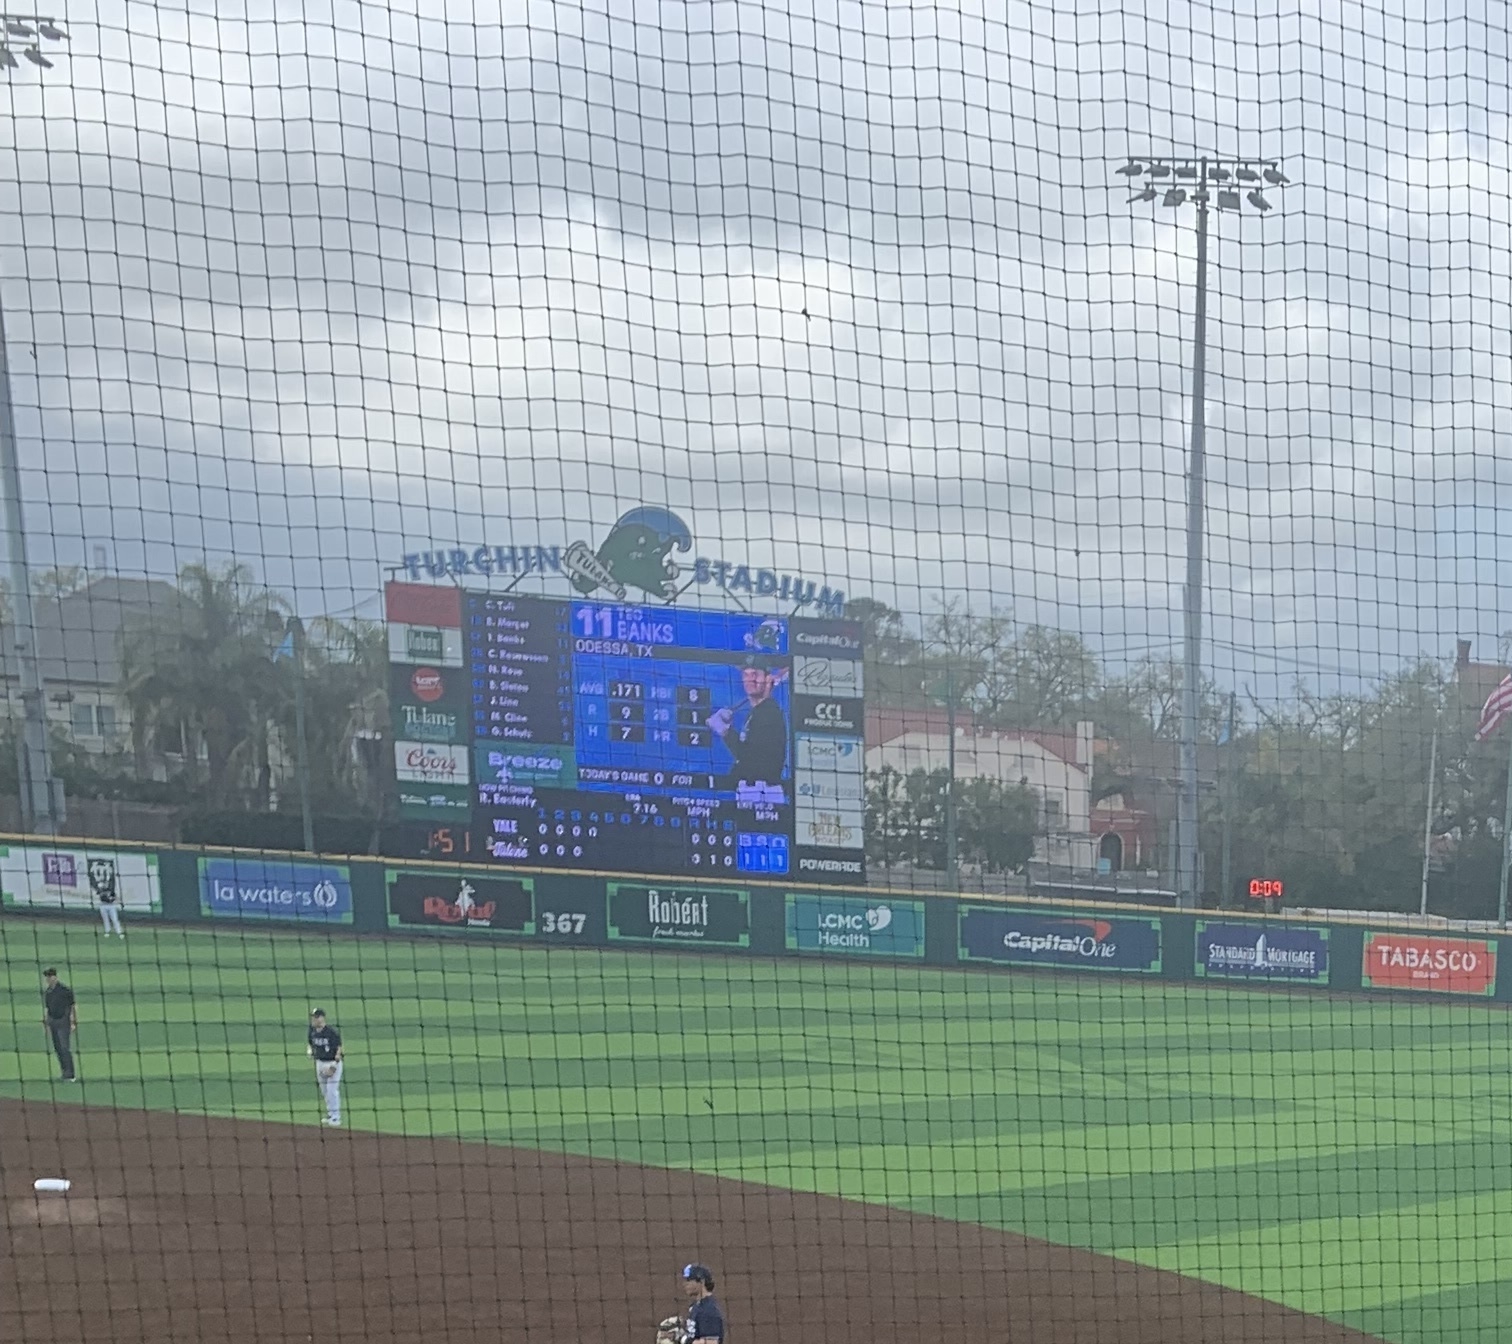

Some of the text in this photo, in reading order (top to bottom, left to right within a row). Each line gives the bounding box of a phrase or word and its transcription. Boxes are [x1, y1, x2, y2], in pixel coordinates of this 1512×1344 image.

[404, 545, 846, 618] TURCHIN STADIUM
[577, 606, 612, 637] 11
[617, 607, 643, 621] TEO
[617, 621, 674, 643] BANKS
[576, 639, 654, 657] ODESSA, TX
[580, 683, 604, 695] AVG
[611, 683, 640, 697] .171
[689, 689, 698, 702] 8
[588, 704, 597, 715] R
[622, 706, 631, 719] 9
[691, 711, 697, 724] 1
[588, 726, 699, 745] H 7 HR 2
[407, 748, 457, 770] Coors
[488, 751, 563, 770] Breeze
[621, 771, 649, 782] GAME
[654, 772, 664, 785] 0
[672, 775, 692, 785] FOR
[708, 776, 714, 788] 1
[493, 819, 518, 834] YALE
[539, 823, 547, 835] 0
[556, 824, 564, 836] 0
[572, 825, 581, 837] 0
[692, 833, 700, 845] 0
[708, 834, 716, 846] 0
[723, 835, 732, 847] 0
[540, 843, 548, 855] 0
[556, 844, 565, 857] 0
[573, 845, 582, 857] 0
[710, 854, 716, 865] 1
[724, 855, 732, 867] 0
[799, 858, 862, 873] POWERADE
[238, 885, 312, 906] waters
[542, 911, 587, 934] 367
[817, 913, 863, 931] LCMC
[818, 931, 870, 948] Health
[1208, 943, 1316, 965] STANDARD MORTGAGE
[1377, 945, 1477, 972] TABASCO
[1412, 970, 1440, 979] BRAND
